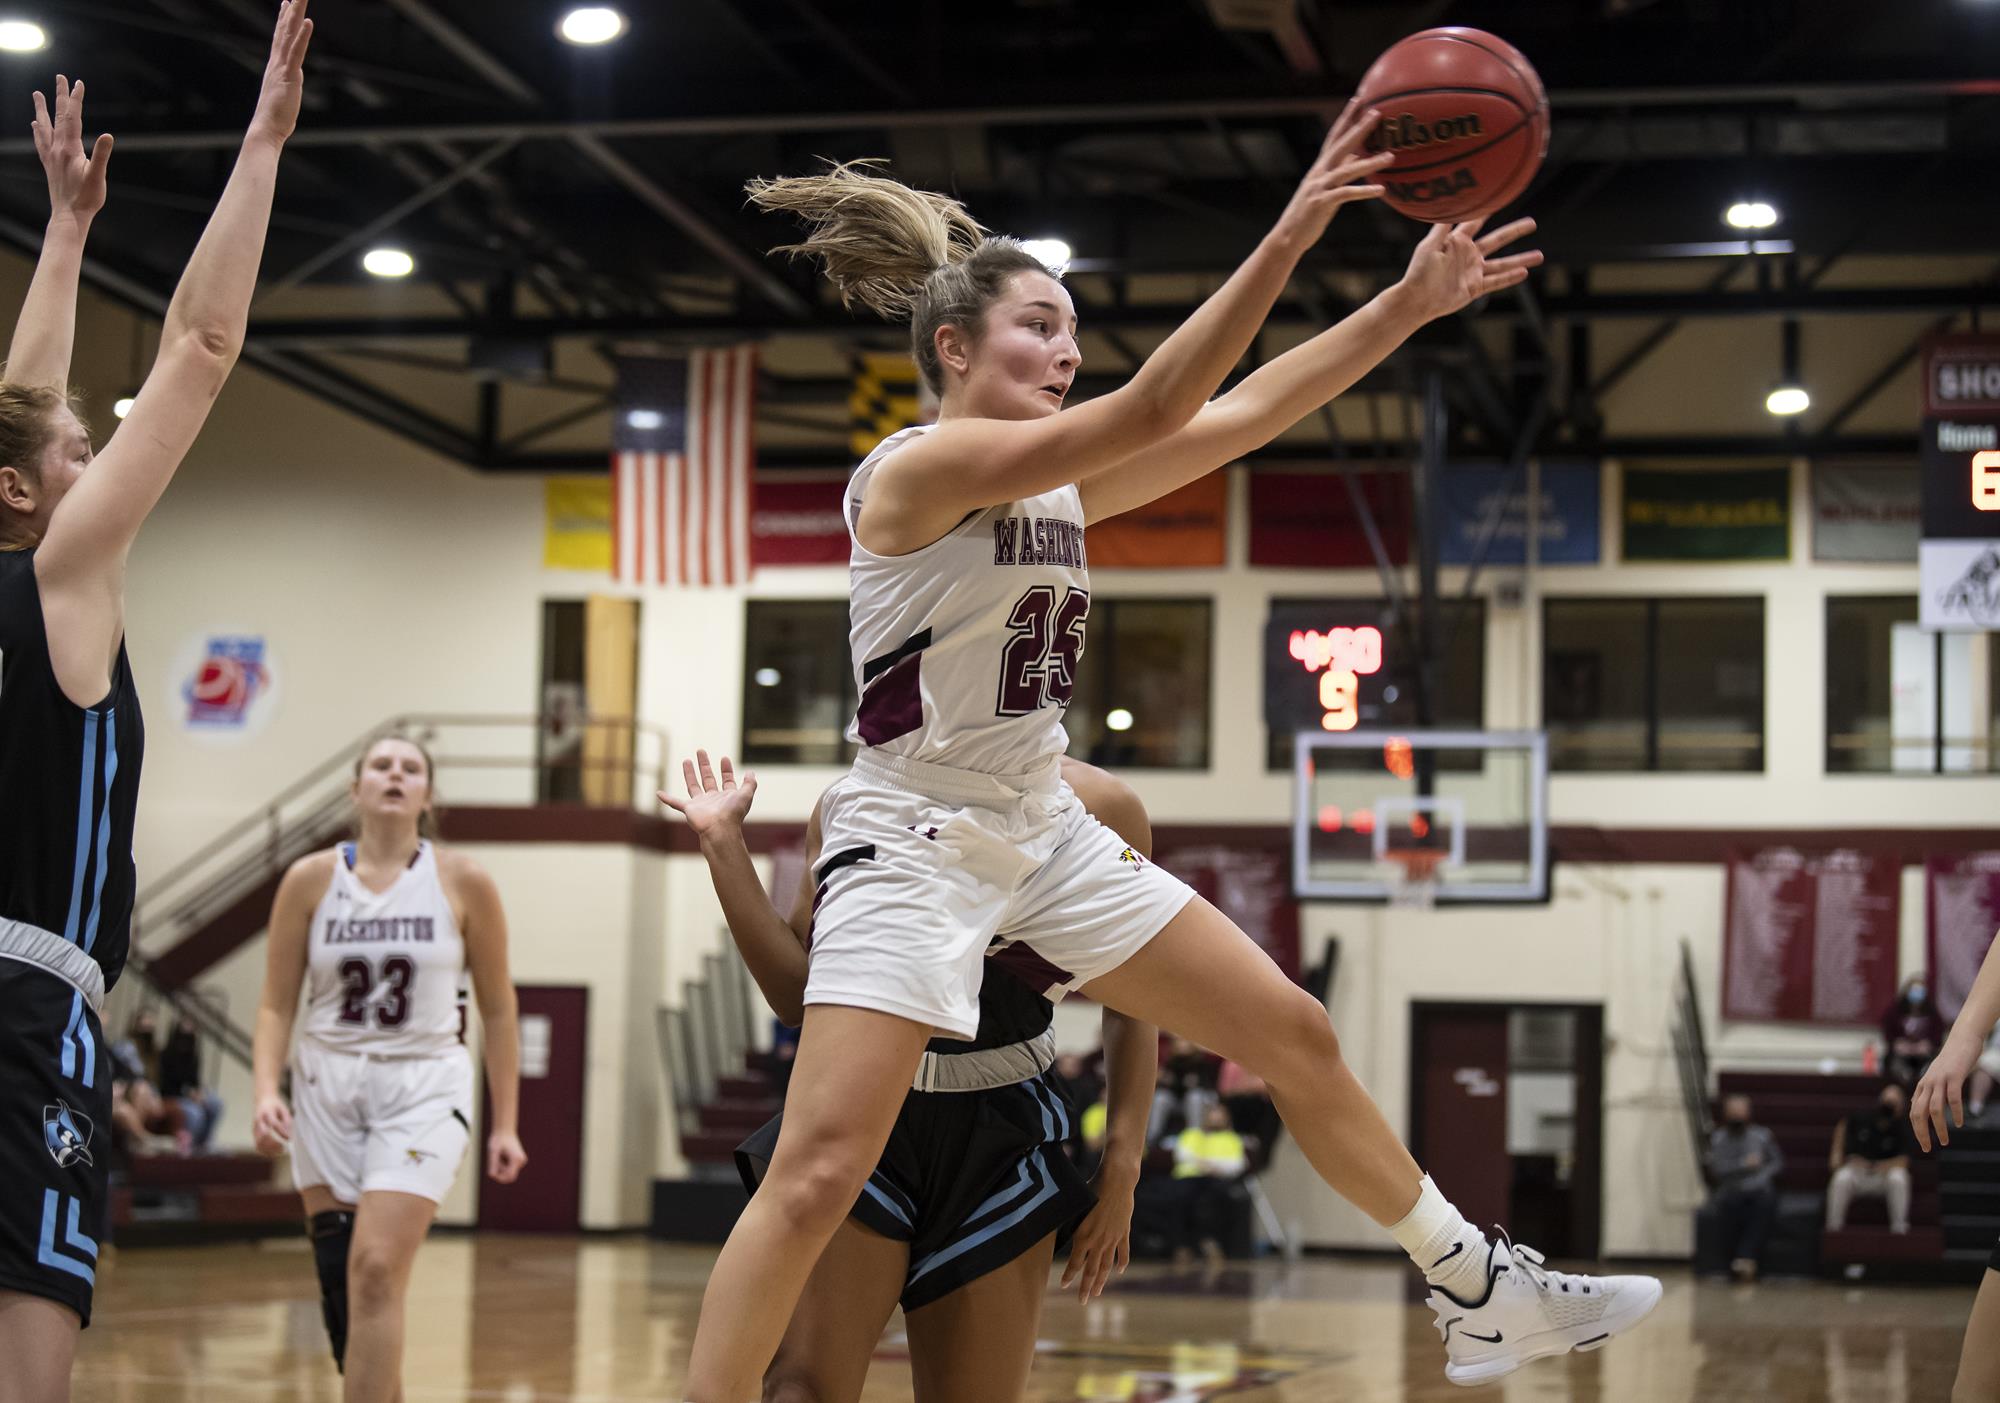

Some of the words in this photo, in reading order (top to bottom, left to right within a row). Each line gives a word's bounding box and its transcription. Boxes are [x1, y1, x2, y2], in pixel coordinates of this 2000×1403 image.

[1366, 112, 1482, 151] ilson
[1937, 421, 1997, 453] Home
[1972, 451, 2000, 511] 6
[996, 585, 1088, 716] 25
[338, 955, 416, 1031] 23
